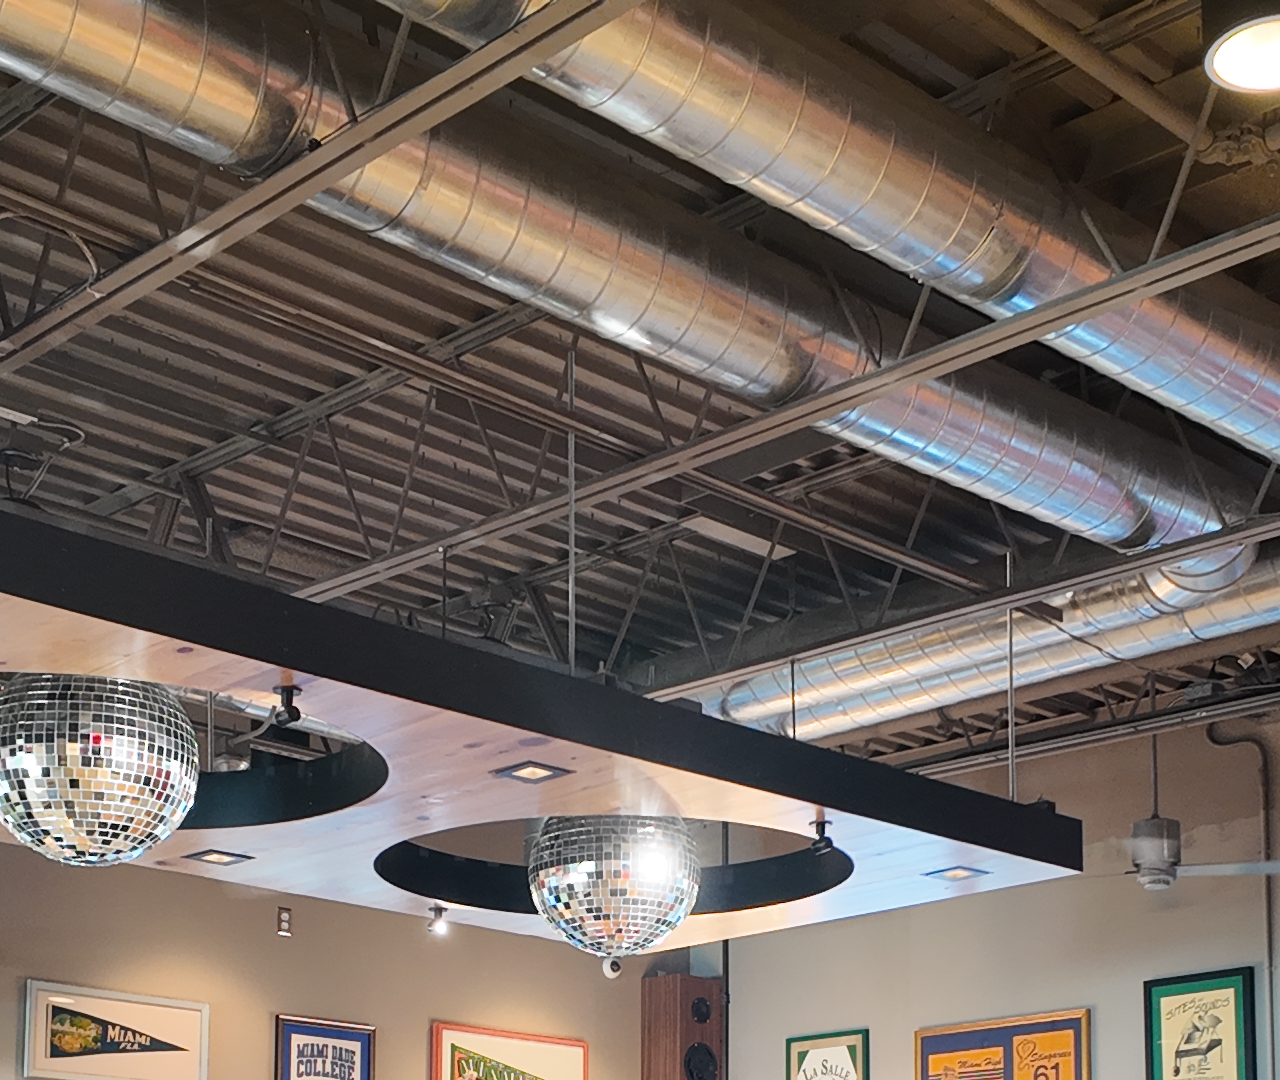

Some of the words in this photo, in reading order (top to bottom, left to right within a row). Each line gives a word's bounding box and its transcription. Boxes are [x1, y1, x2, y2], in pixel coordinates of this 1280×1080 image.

[106, 1024, 151, 1046] MIAMI
[296, 1043, 329, 1059] MIAMI
[331, 1045, 356, 1065] DADE
